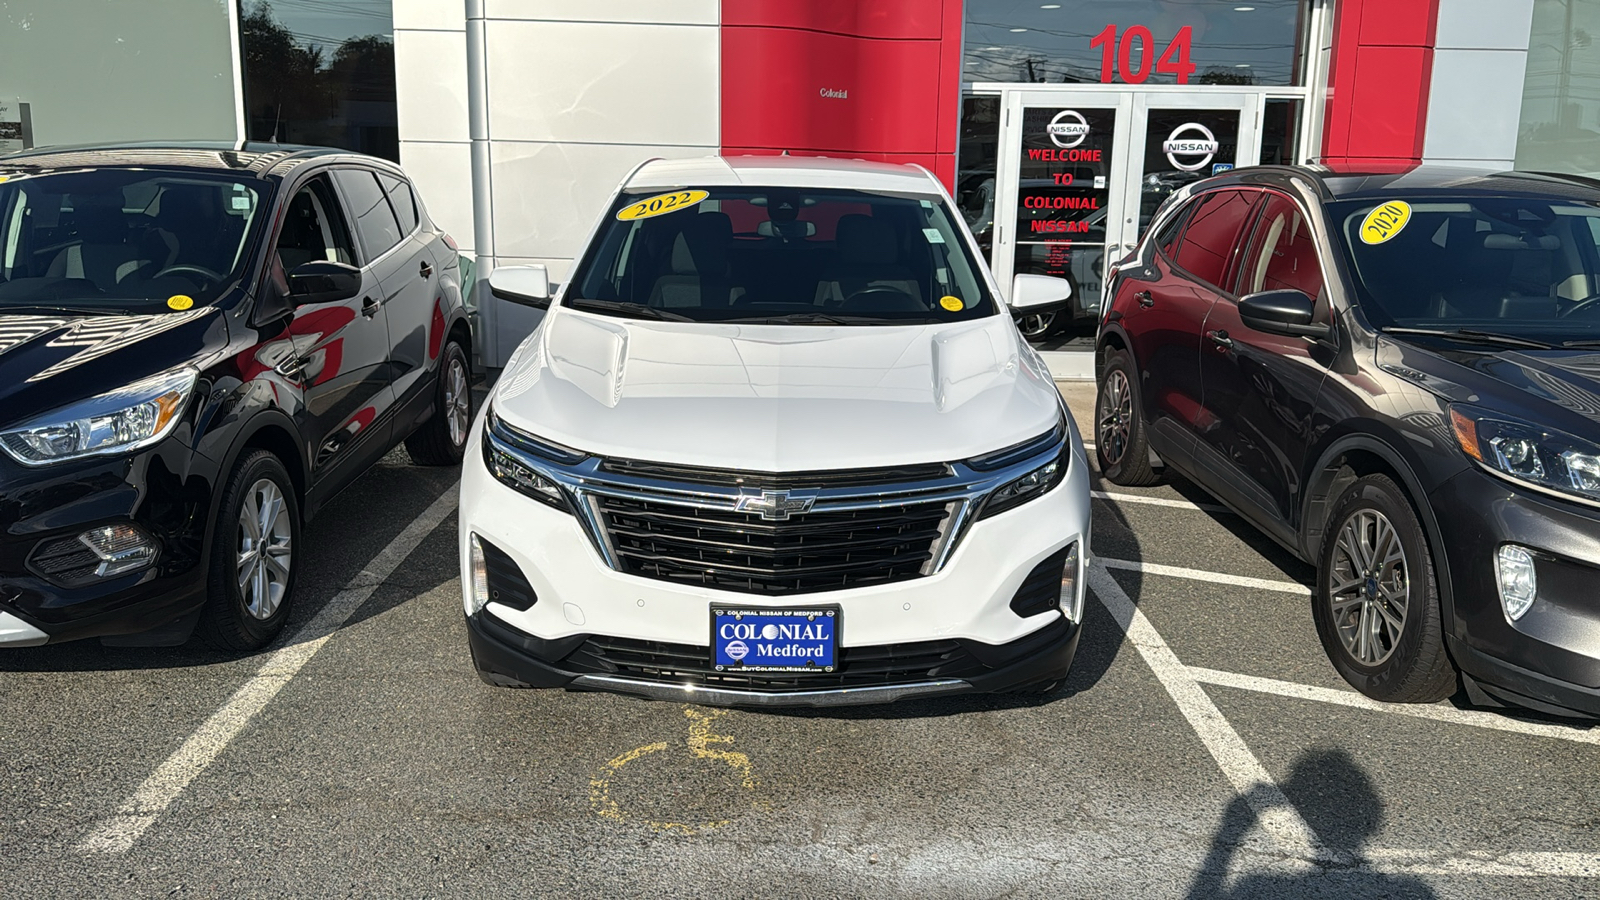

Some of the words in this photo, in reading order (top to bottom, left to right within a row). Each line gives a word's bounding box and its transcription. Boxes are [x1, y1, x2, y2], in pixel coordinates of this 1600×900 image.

[1090, 24, 1197, 85] 104
[819, 87, 848, 99] Colonial
[1167, 143, 1214, 151] NISSAN
[1028, 149, 1102, 162] WELCOME
[1052, 173, 1074, 186] TO
[634, 192, 692, 217] 2022
[1024, 196, 1100, 210] COLONIAL
[1030, 219, 1090, 233] NISSAN
[1367, 205, 1404, 238] 2020
[720, 623, 830, 640] COLONIAL
[756, 643, 824, 657] Medford
